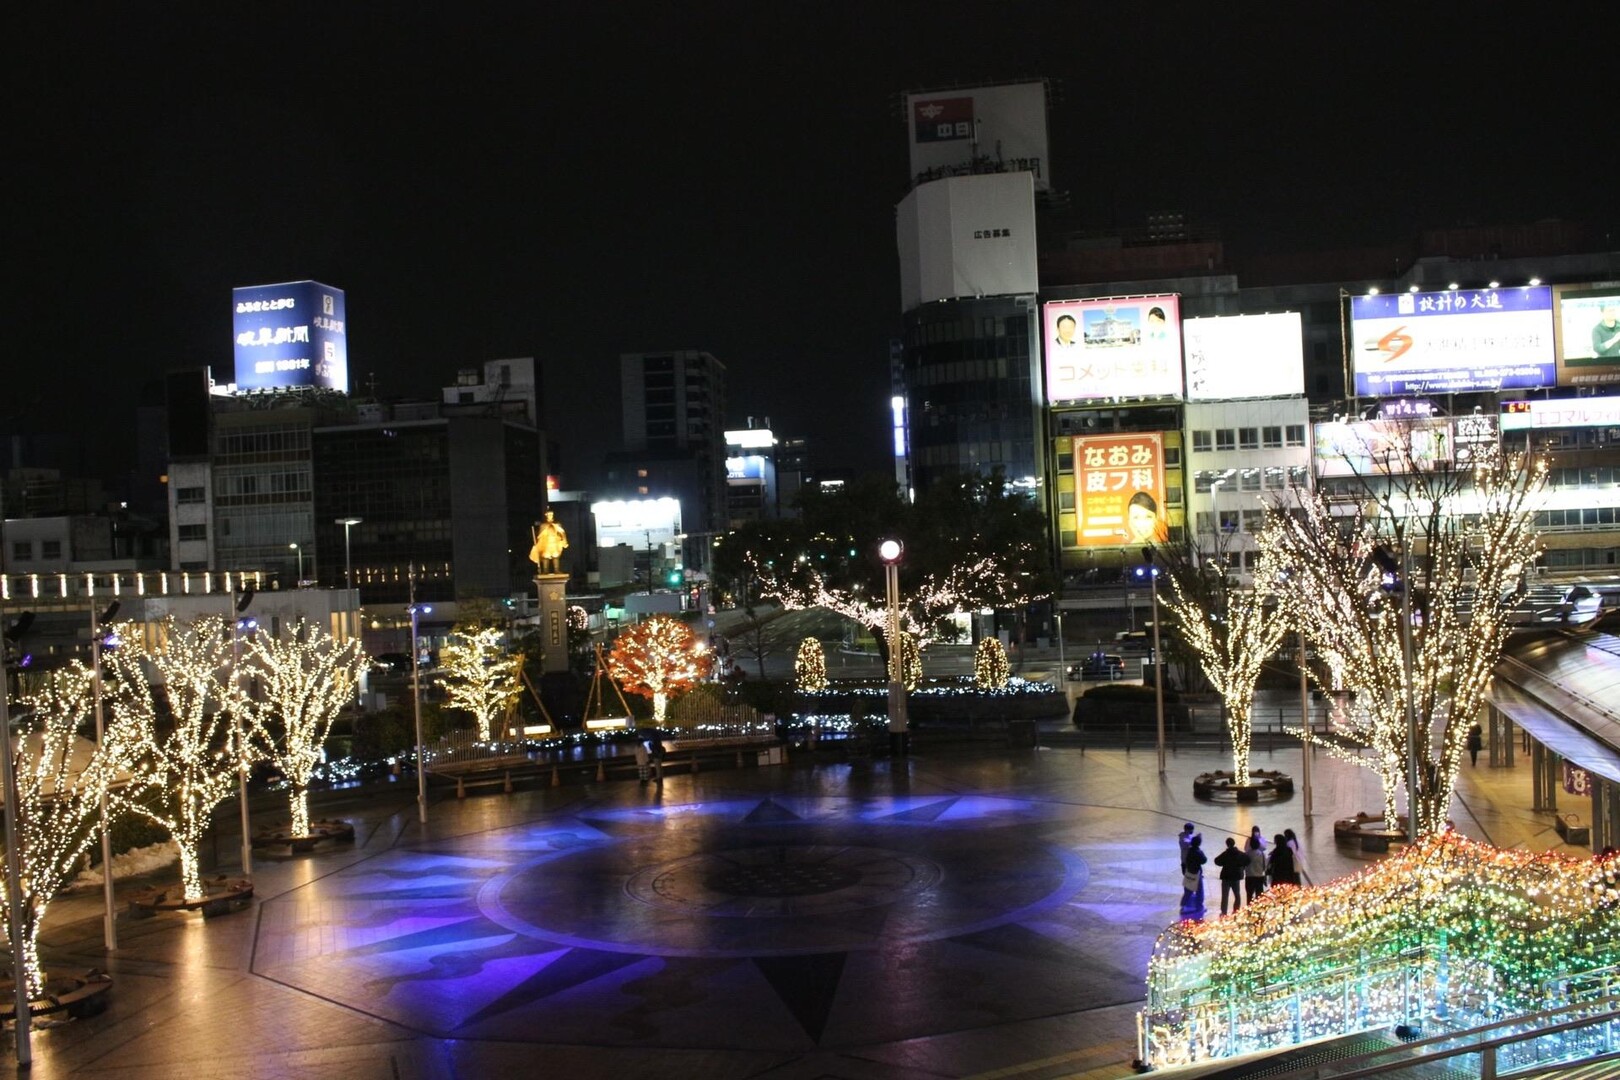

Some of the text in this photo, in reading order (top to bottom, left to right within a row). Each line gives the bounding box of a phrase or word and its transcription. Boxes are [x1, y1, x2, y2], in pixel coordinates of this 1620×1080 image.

[973, 228, 1011, 240] 広告募集
[1084, 444, 1153, 468] なおみ
[1086, 468, 1154, 493] 皮フ科
[1573, 769, 1586, 792] 8
